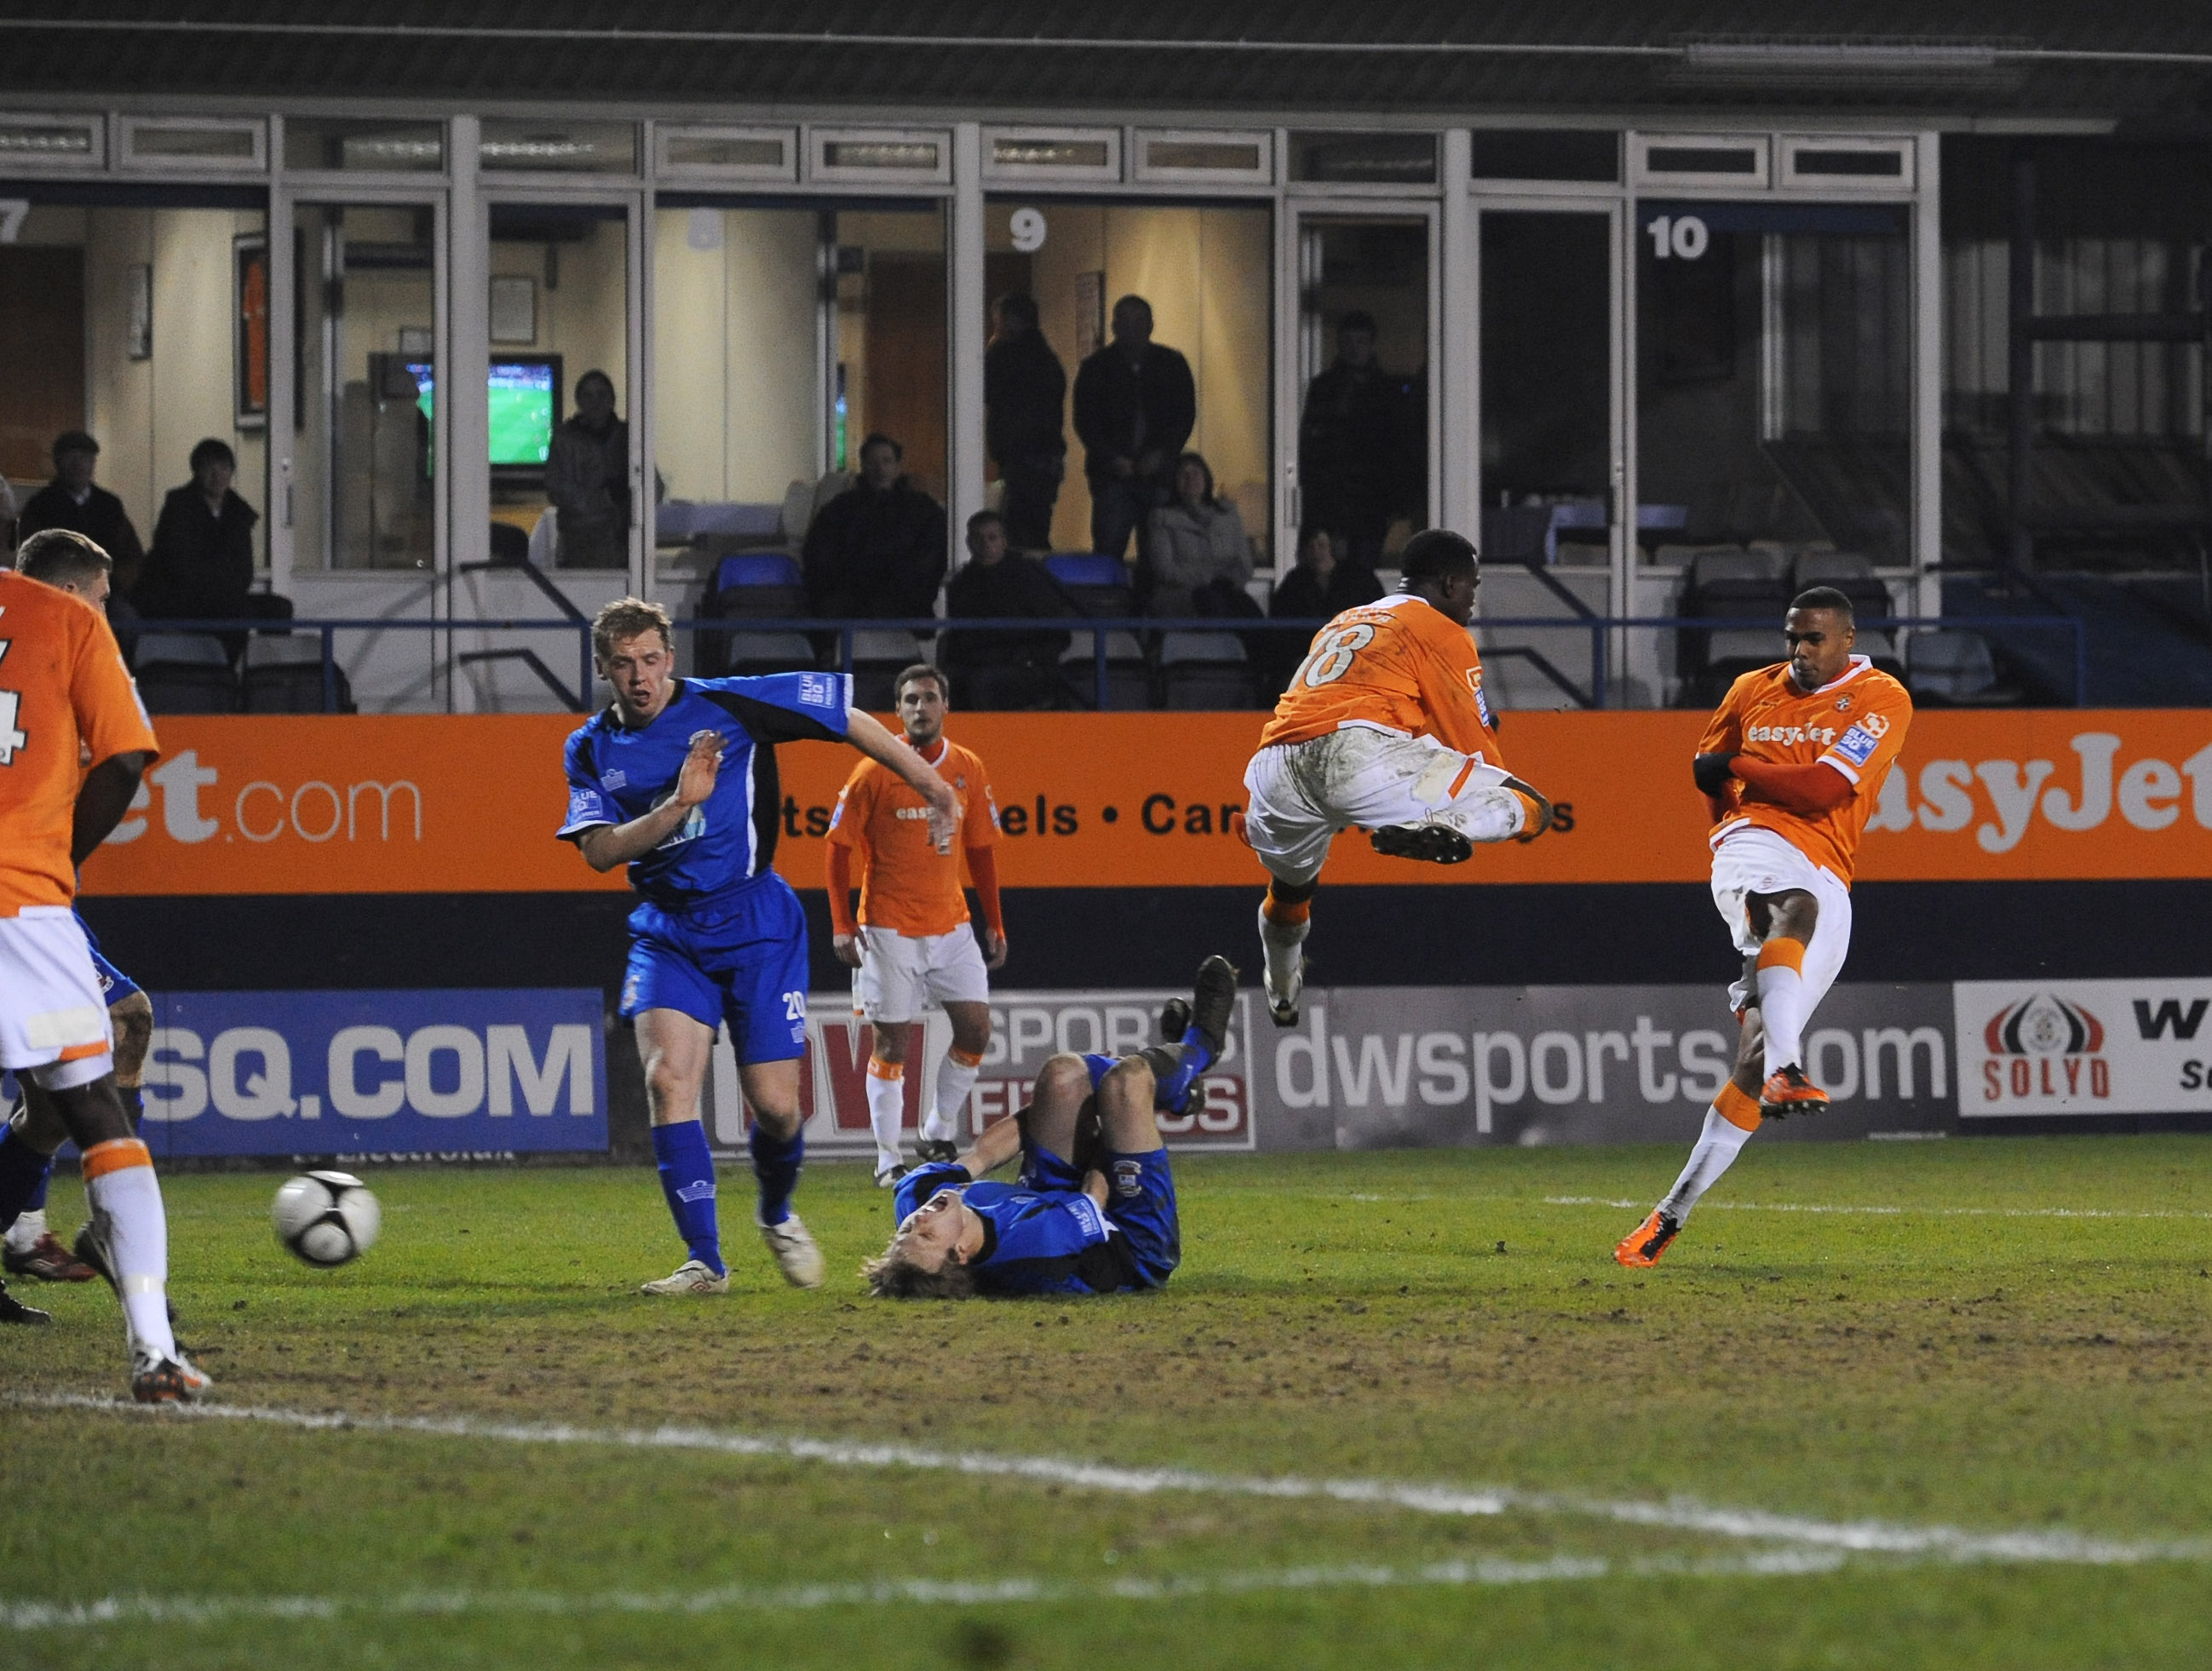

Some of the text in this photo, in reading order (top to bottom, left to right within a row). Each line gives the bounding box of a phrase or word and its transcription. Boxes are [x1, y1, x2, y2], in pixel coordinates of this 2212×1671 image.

[0, 198, 30, 244] 7
[1009, 207, 1047, 252] 9
[1646, 215, 1709, 260] 10
[1285, 623, 1375, 688] 18
[1747, 721, 1836, 747] easyJet
[1846, 727, 1876, 749] BLUE
[782, 991, 806, 1020] 20
[2133, 999, 2210, 1040] W
[2180, 1059, 2212, 1090] S
